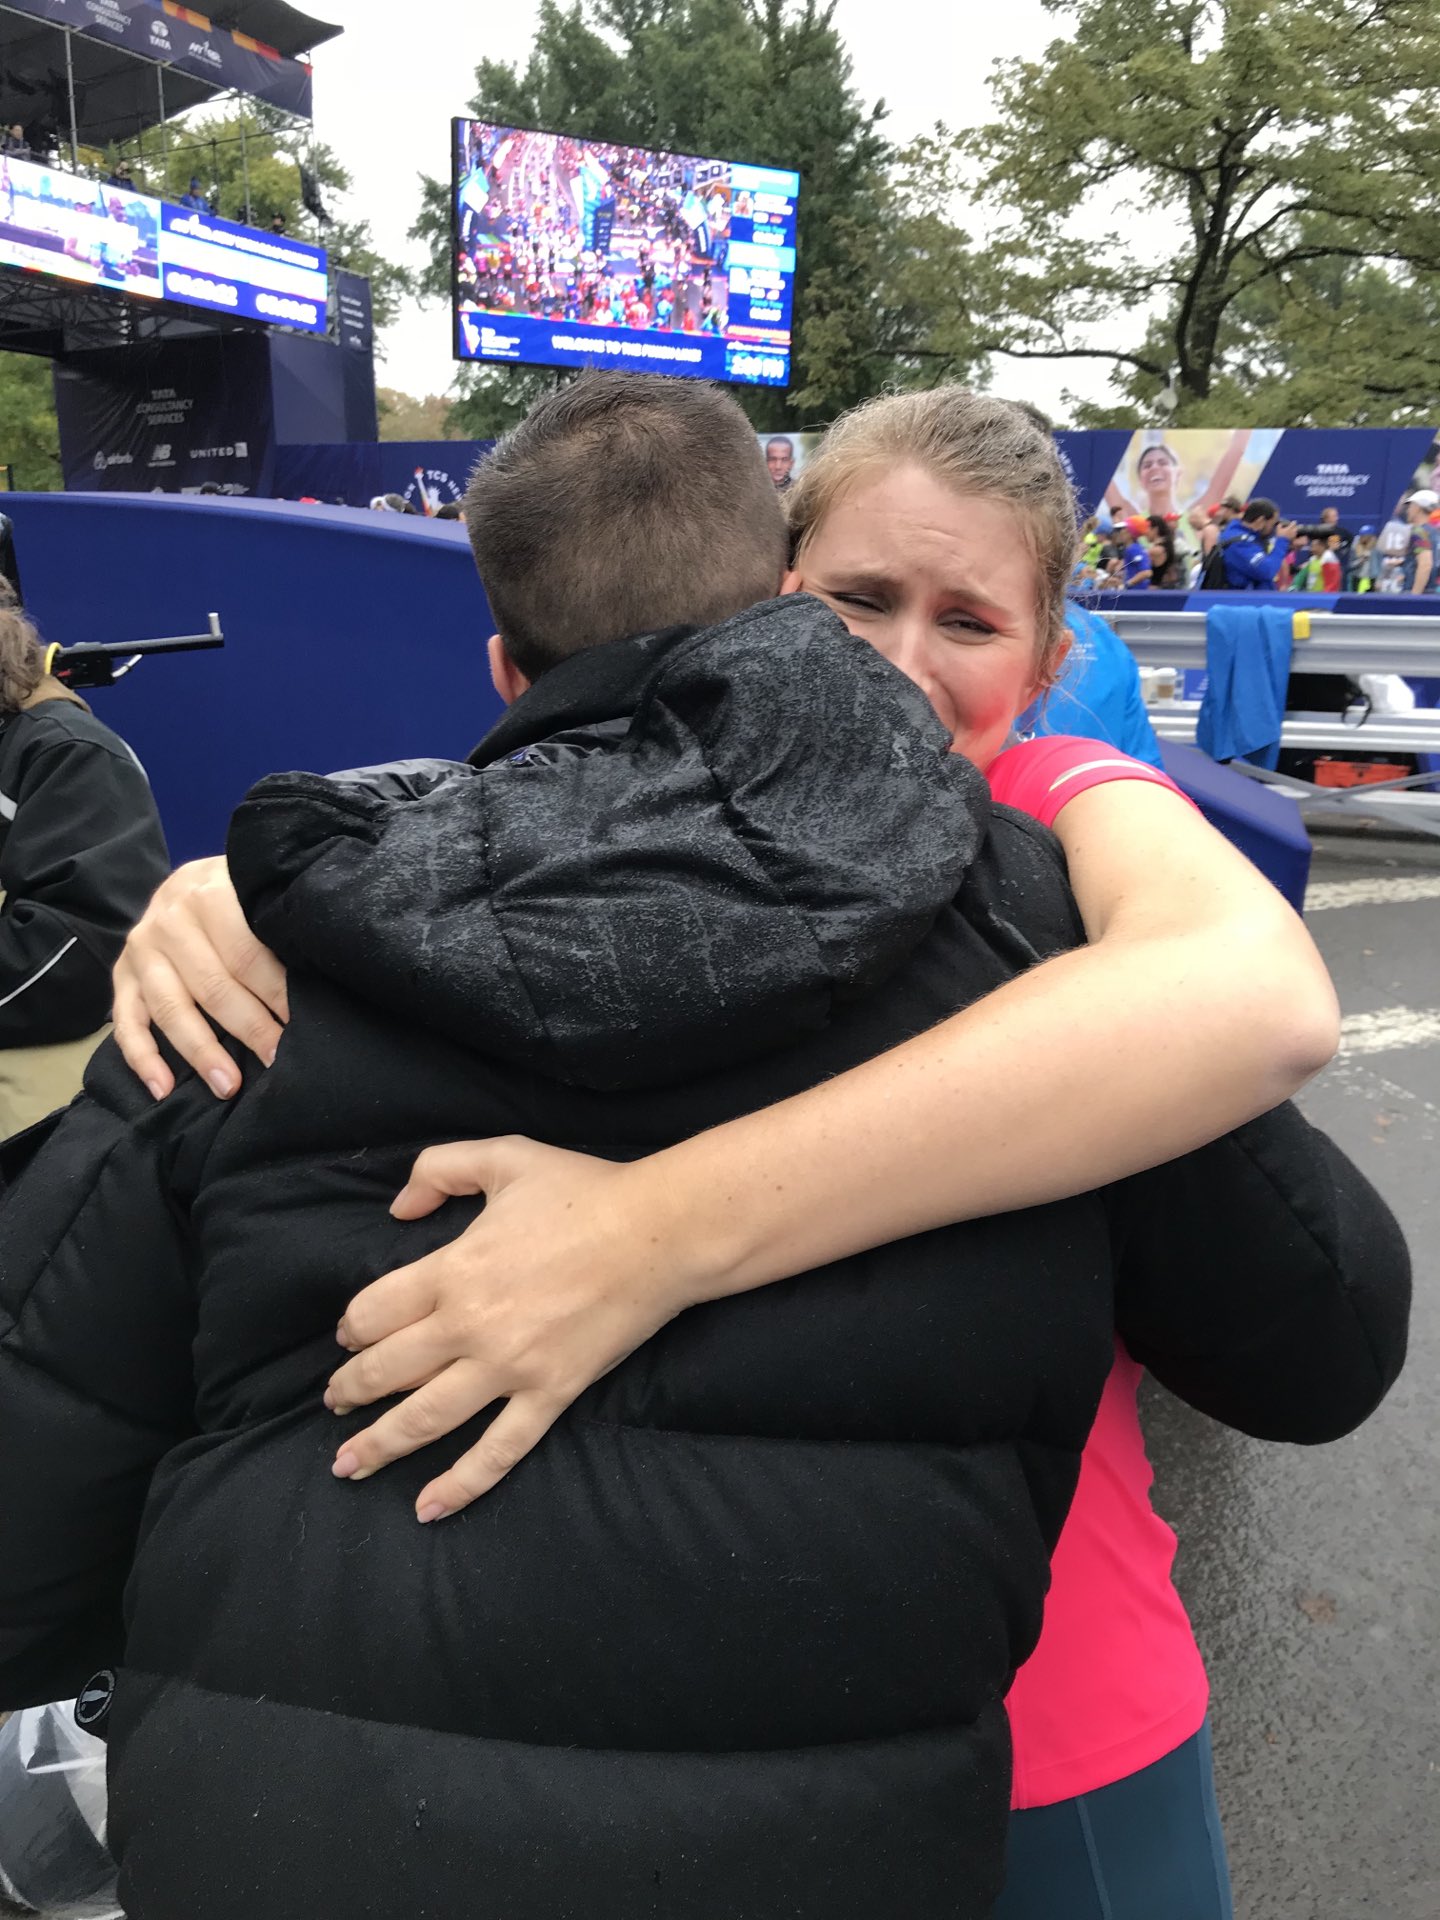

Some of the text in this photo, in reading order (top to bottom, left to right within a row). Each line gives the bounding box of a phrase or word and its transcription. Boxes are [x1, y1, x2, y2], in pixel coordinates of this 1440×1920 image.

[149, 35, 172, 51] TATA
[552, 335, 605, 353] WELCOME
[606, 340, 621, 355] TO
[152, 388, 176, 400] TATA
[136, 399, 193, 414] CONSULTANCY
[148, 412, 185, 426] SERVICES
[189, 447, 234, 459] UNITED
[1316, 463, 1350, 475] TATA
[426, 469, 449, 483] TCS
[1294, 474, 1370, 487] CONSULTANCY
[1306, 486, 1355, 497] SERVICES
